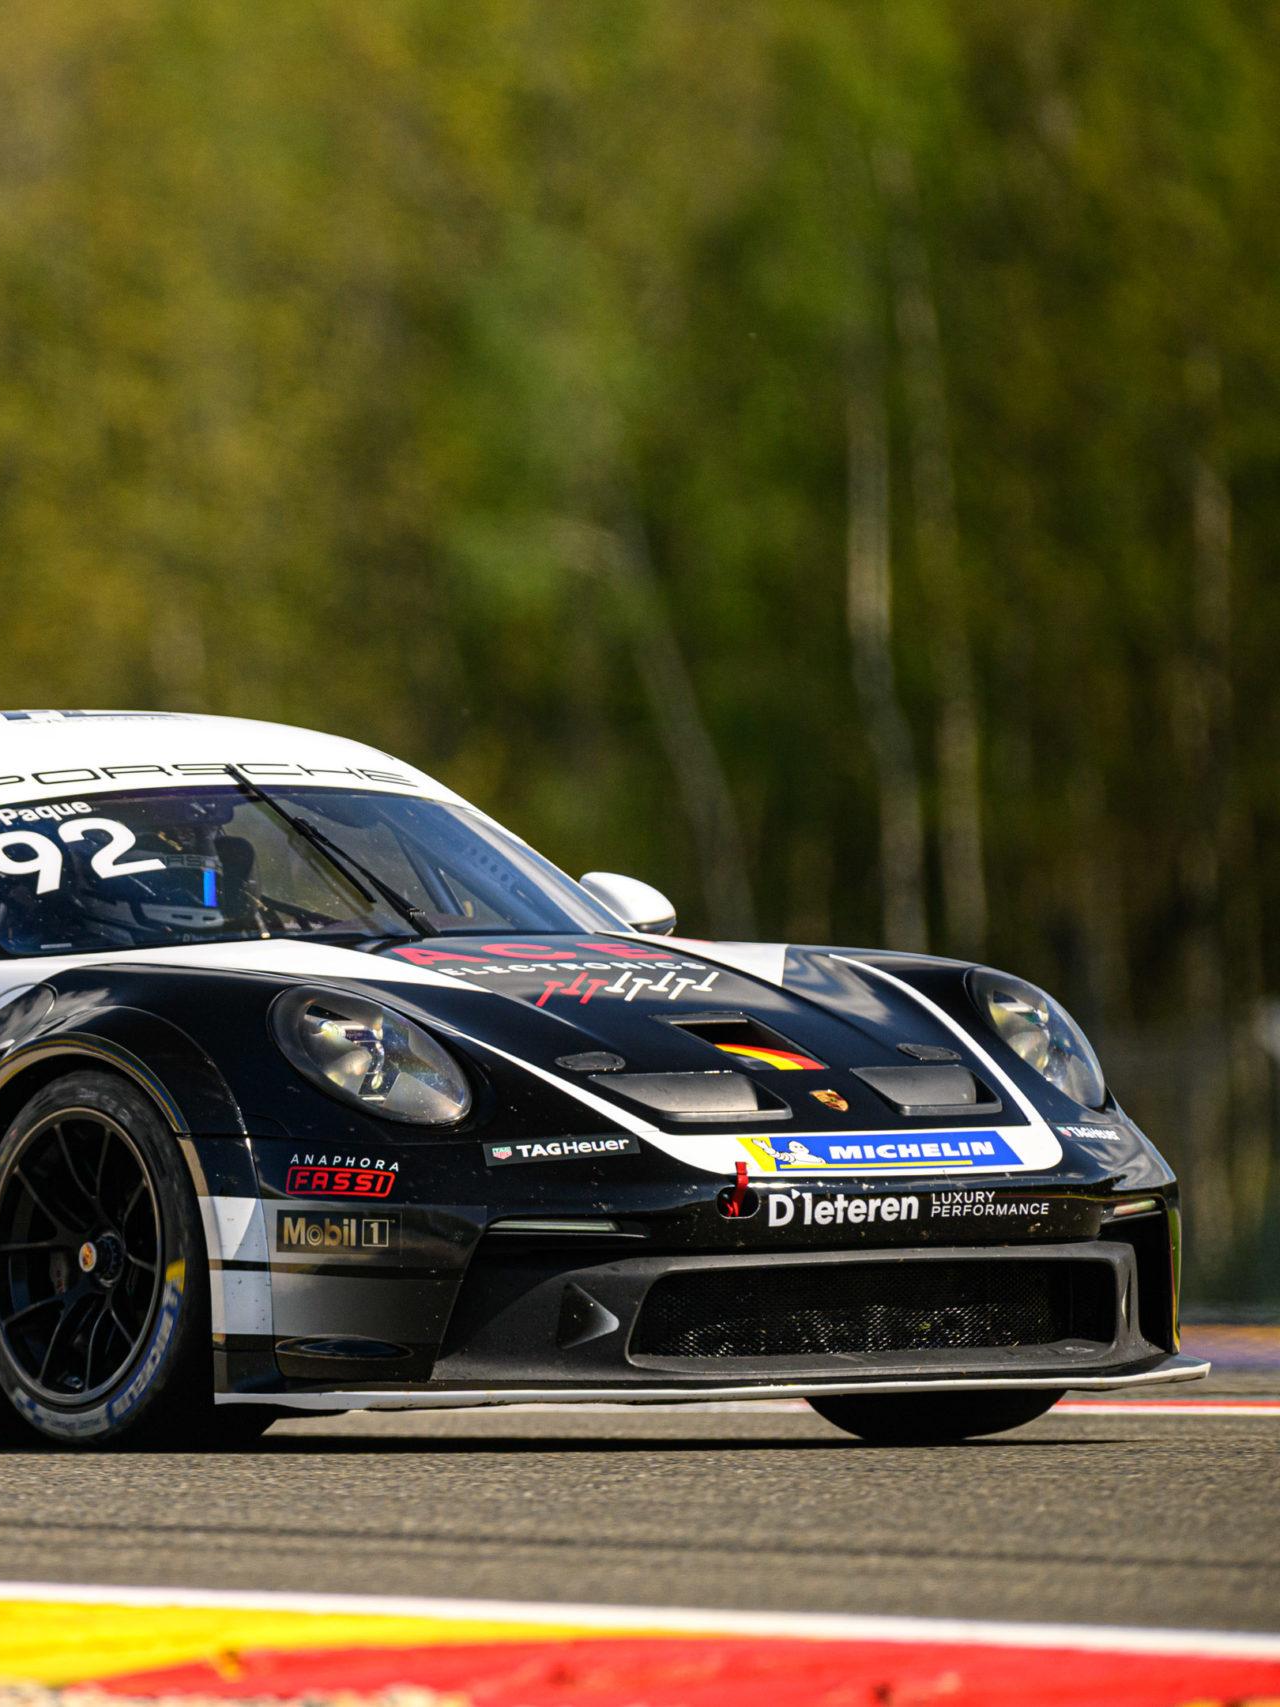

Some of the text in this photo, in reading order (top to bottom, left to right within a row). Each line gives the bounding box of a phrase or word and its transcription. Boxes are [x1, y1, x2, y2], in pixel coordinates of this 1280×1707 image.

[1, 799, 94, 828] Paque
[391, 943, 673, 966] ACE
[437, 961, 707, 977] ELECTRONICS
[829, 1140, 995, 1160] MICHELIN
[290, 1153, 400, 1172] ANAPHORA
[293, 1171, 385, 1192] FASSI
[930, 1191, 996, 1205] LUXURY
[930, 1202, 1050, 1218] PERFORMANCE
[282, 1216, 357, 1247] Mobil
